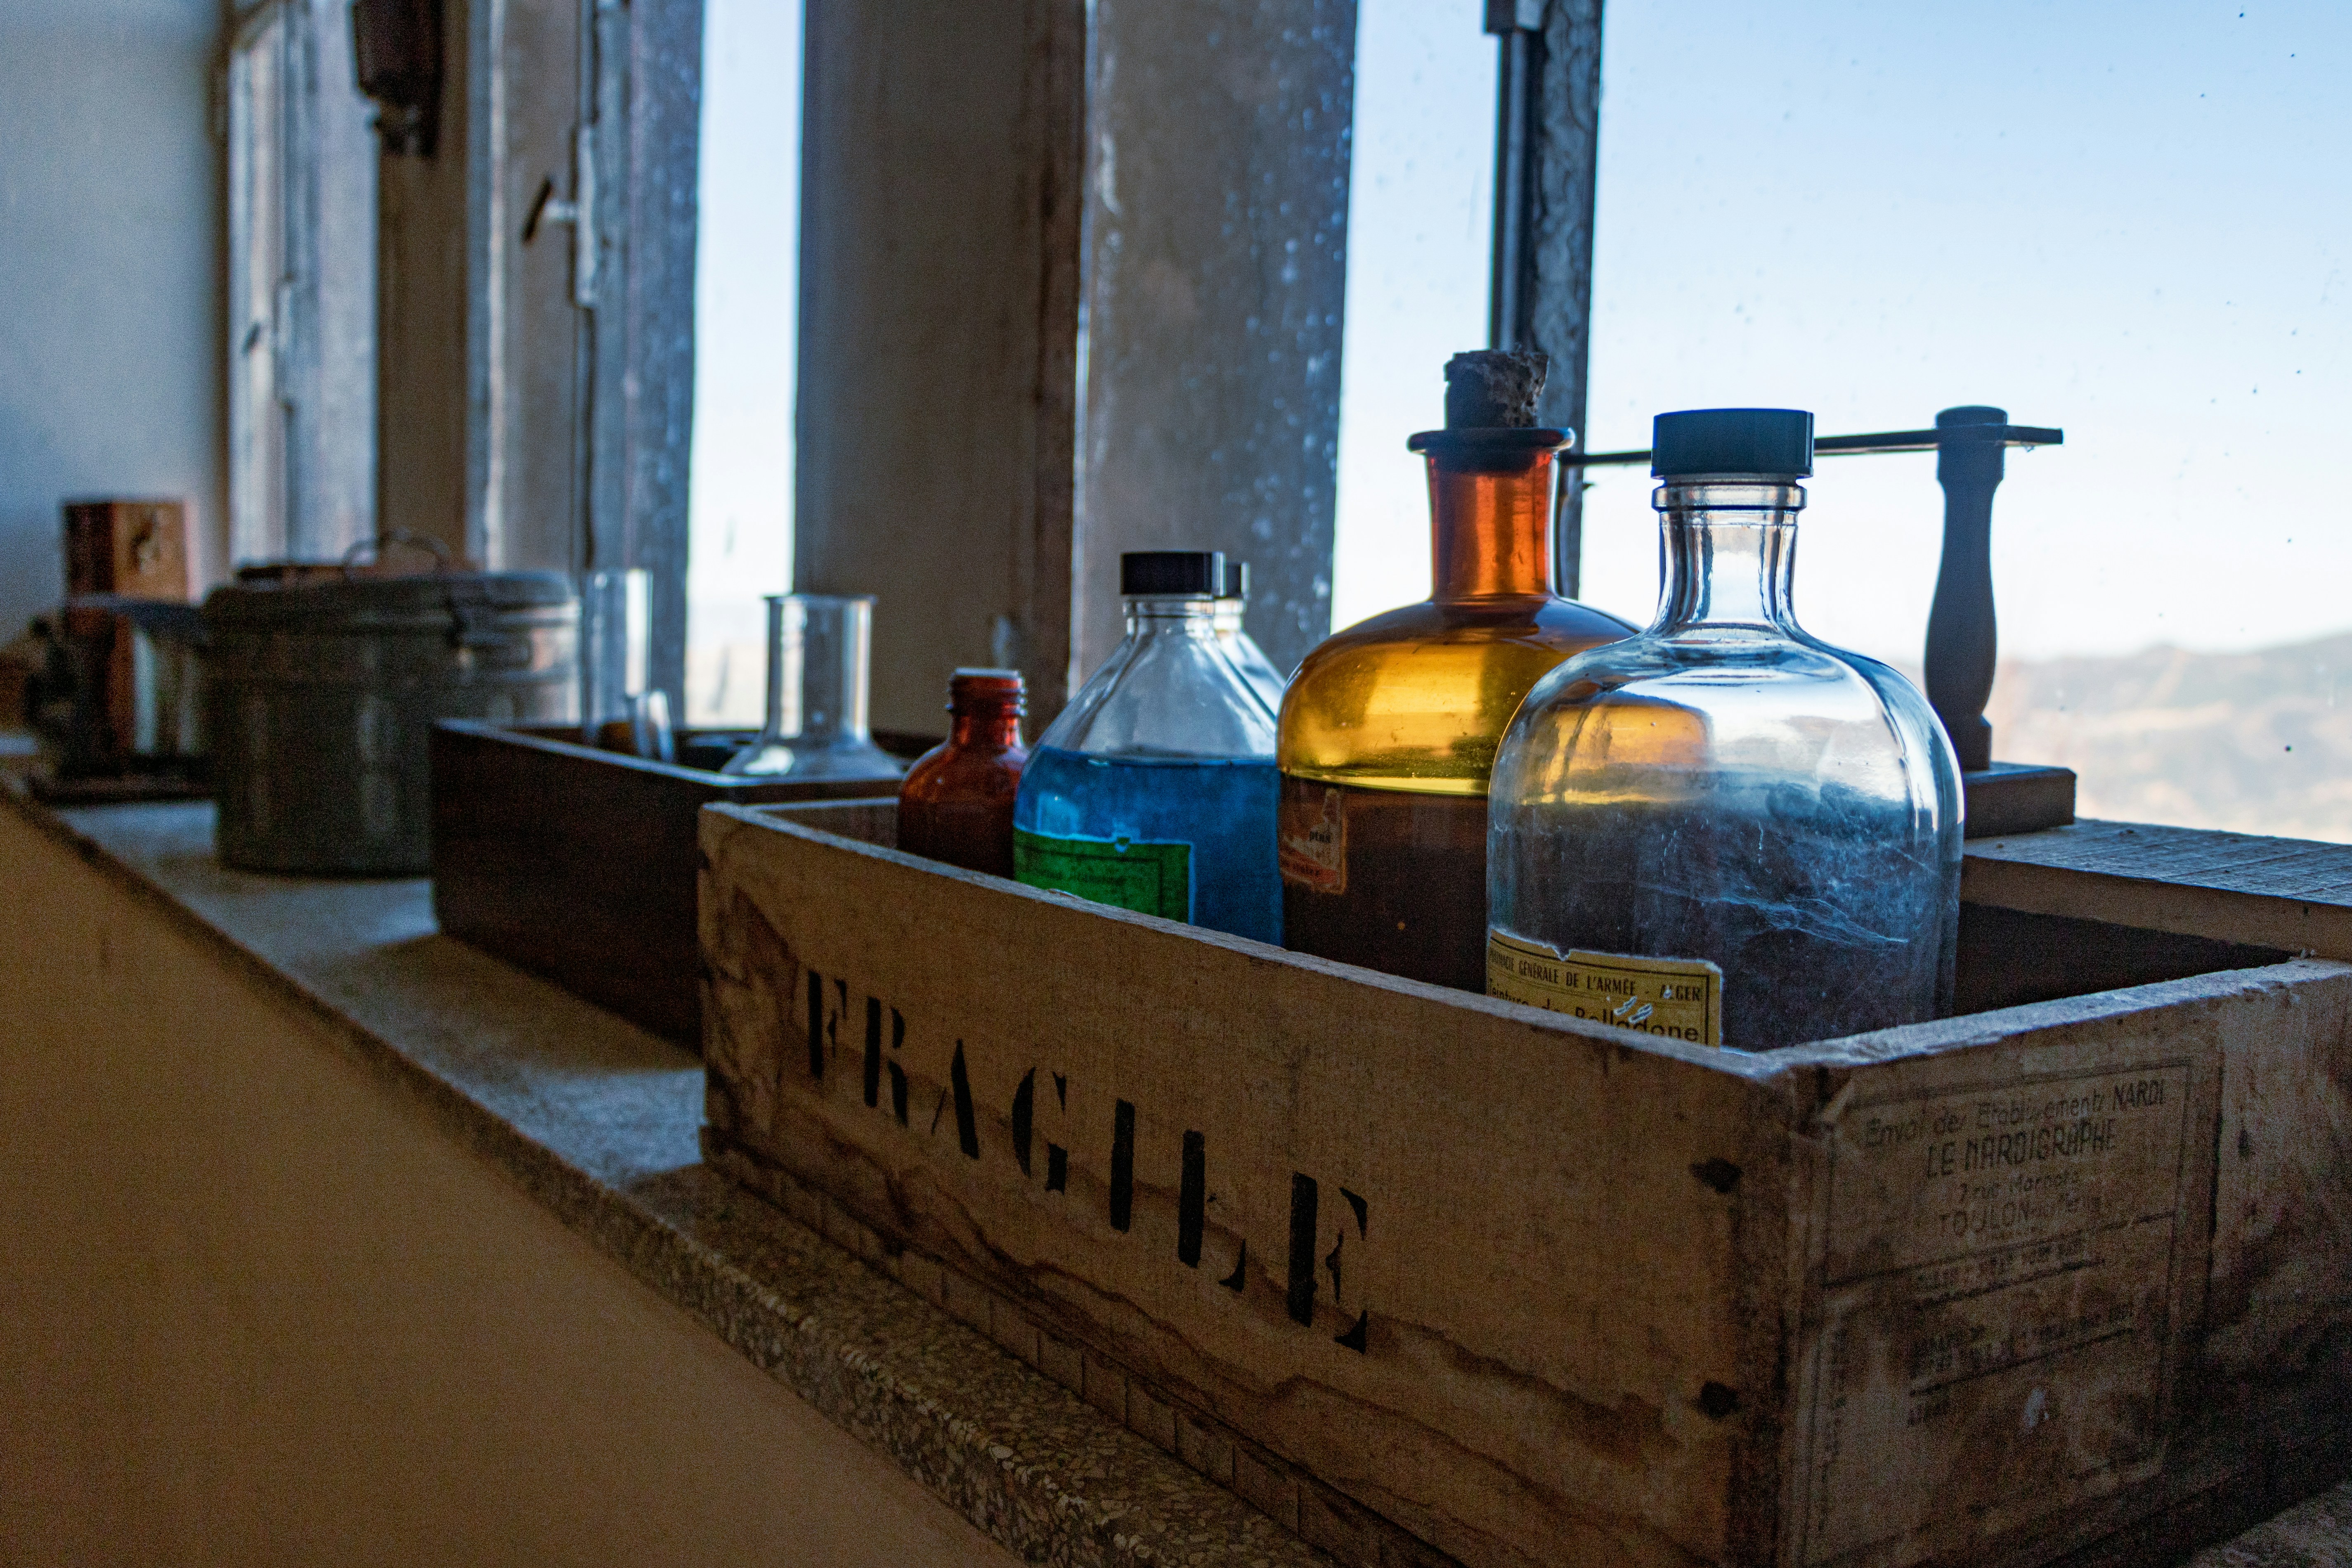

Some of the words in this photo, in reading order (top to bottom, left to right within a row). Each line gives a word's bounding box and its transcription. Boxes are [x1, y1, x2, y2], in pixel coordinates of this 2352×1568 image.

[1566, 971, 1579, 988] DE
[2113, 1079, 2165, 1111] NARDI
[807, 969, 1368, 1354] FRAGILE
[1926, 1141, 1956, 1179] LE
[1964, 1119, 2118, 1171] NARDIGRAPHE
